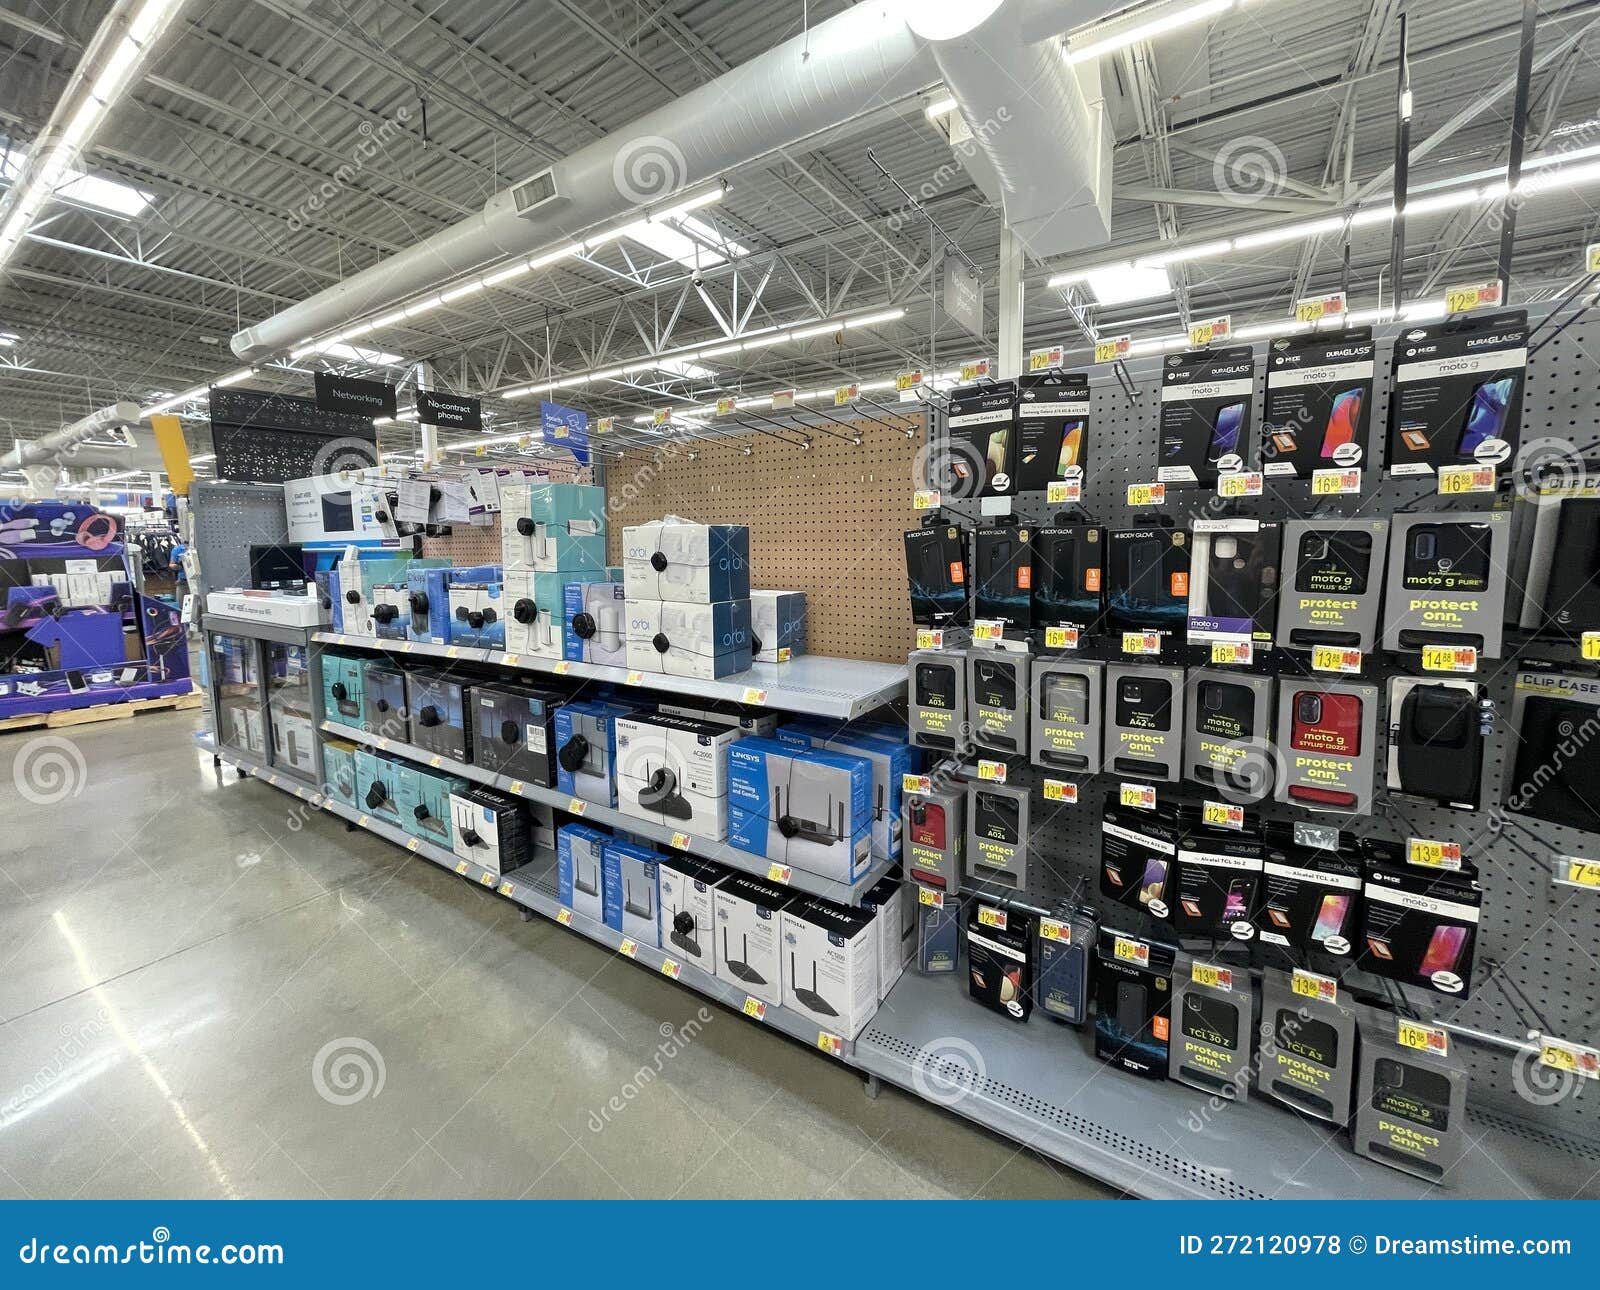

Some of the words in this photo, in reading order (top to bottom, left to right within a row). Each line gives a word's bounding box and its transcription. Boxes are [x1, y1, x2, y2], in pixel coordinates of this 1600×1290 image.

[1467, 332, 1524, 347] DURAGLASS
[1326, 346, 1372, 357] DURAGLASS
[1440, 362, 1468, 372] moto
[1304, 372, 1327, 380] moto
[1192, 386, 1212, 395] moto
[333, 389, 383, 406] Networking
[428, 400, 470, 413] No-contract
[437, 411, 463, 421] phones
[629, 547, 647, 558] orbi
[719, 554, 744, 571] orbi
[1311, 575, 1342, 583] moto
[1344, 576, 1353, 585] g
[1445, 577, 1455, 586] g
[1300, 599, 1358, 610] protect
[1409, 600, 1478, 612] protect
[1311, 610, 1343, 619] onn.
[1423, 612, 1462, 622] onn.
[632, 617, 650, 630] orbi
[723, 628, 745, 646] orbi
[1523, 674, 1554, 686] CLIP
[1559, 680, 1599, 693] CASE
[648, 715, 702, 728] NETGEAR
[919, 711, 952, 722] protect
[979, 710, 1013, 722] protect
[926, 720, 945, 728] onn.
[986, 719, 1006, 728] onn.
[1129, 718, 1147, 727] A42
[1207, 718, 1231, 728] moto
[1044, 727, 1085, 739] protect
[1120, 732, 1165, 744] protect
[1304, 733, 1333, 742] moto
[1337, 736, 1345, 745] g
[779, 735, 806, 746] LINKSYS
[1052, 737, 1075, 746] onn.
[1129, 743, 1154, 752] onn.
[1201, 741, 1247, 759] protect
[731, 751, 760, 762] LINKSYS
[1210, 752, 1236, 765] onn.
[1296, 757, 1353, 771] protect
[1308, 769, 1340, 780] onn.
[912, 847, 943, 861] protect
[979, 842, 1014, 856] protect
[919, 857, 936, 866] onn.
[986, 851, 1007, 862] onn.
[736, 879, 780, 898] NETGEAR
[1402, 897, 1428, 907] moto
[805, 901, 852, 924] NETGEAR
[1189, 1028, 1206, 1040] TCL
[1185, 1042, 1232, 1063] protect
[1287, 1041, 1305, 1055] TCL
[1309, 1050, 1323, 1061] A3
[1195, 1054, 1222, 1068] onn.
[1278, 1054, 1331, 1081] protect
[1288, 1068, 1318, 1085] onn.
[1387, 1097, 1417, 1112] moto
[1422, 1107, 1431, 1118] g
[1379, 1119, 1439, 1148] protect
[1391, 1134, 1425, 1152] onn.
